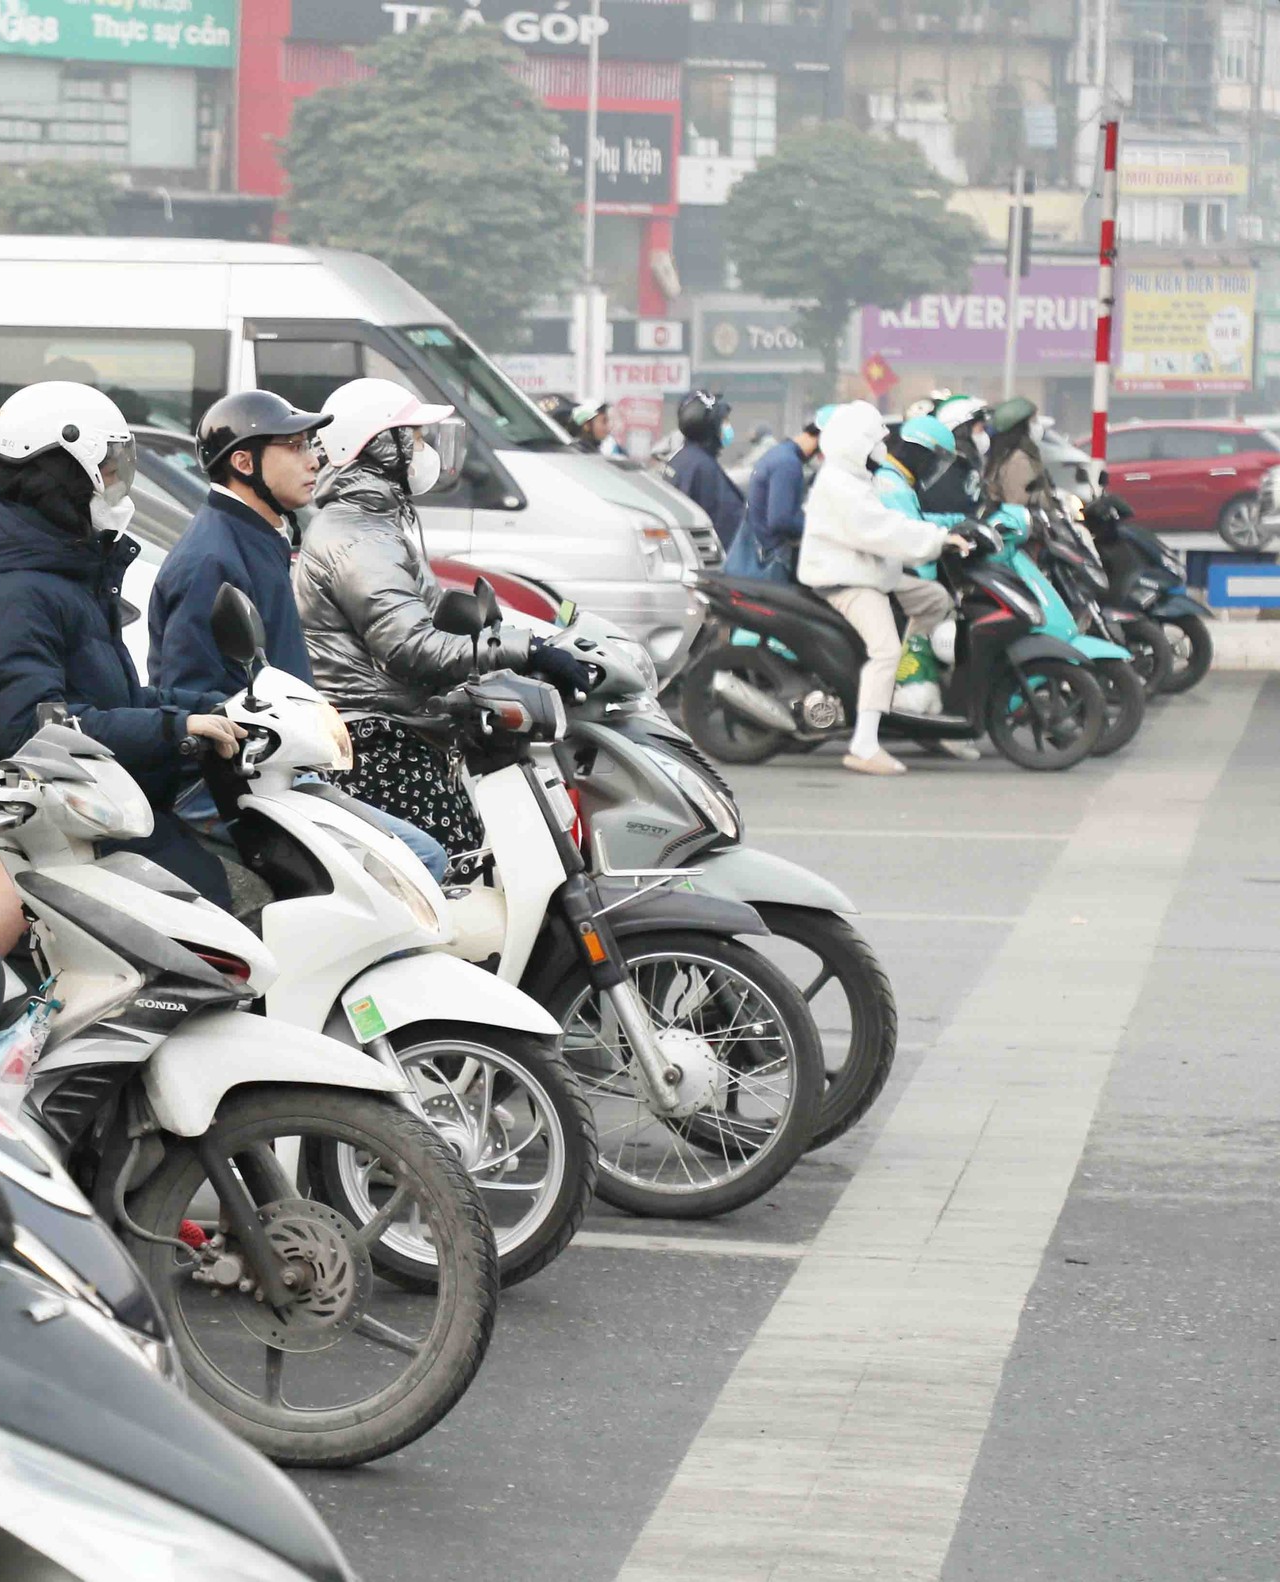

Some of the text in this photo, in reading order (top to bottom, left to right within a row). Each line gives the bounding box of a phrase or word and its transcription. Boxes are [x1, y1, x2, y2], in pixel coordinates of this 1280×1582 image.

[503, 1, 609, 45] GÓP
[624, 136, 662, 184] kiện
[624, 821, 671, 836] SPORTY
